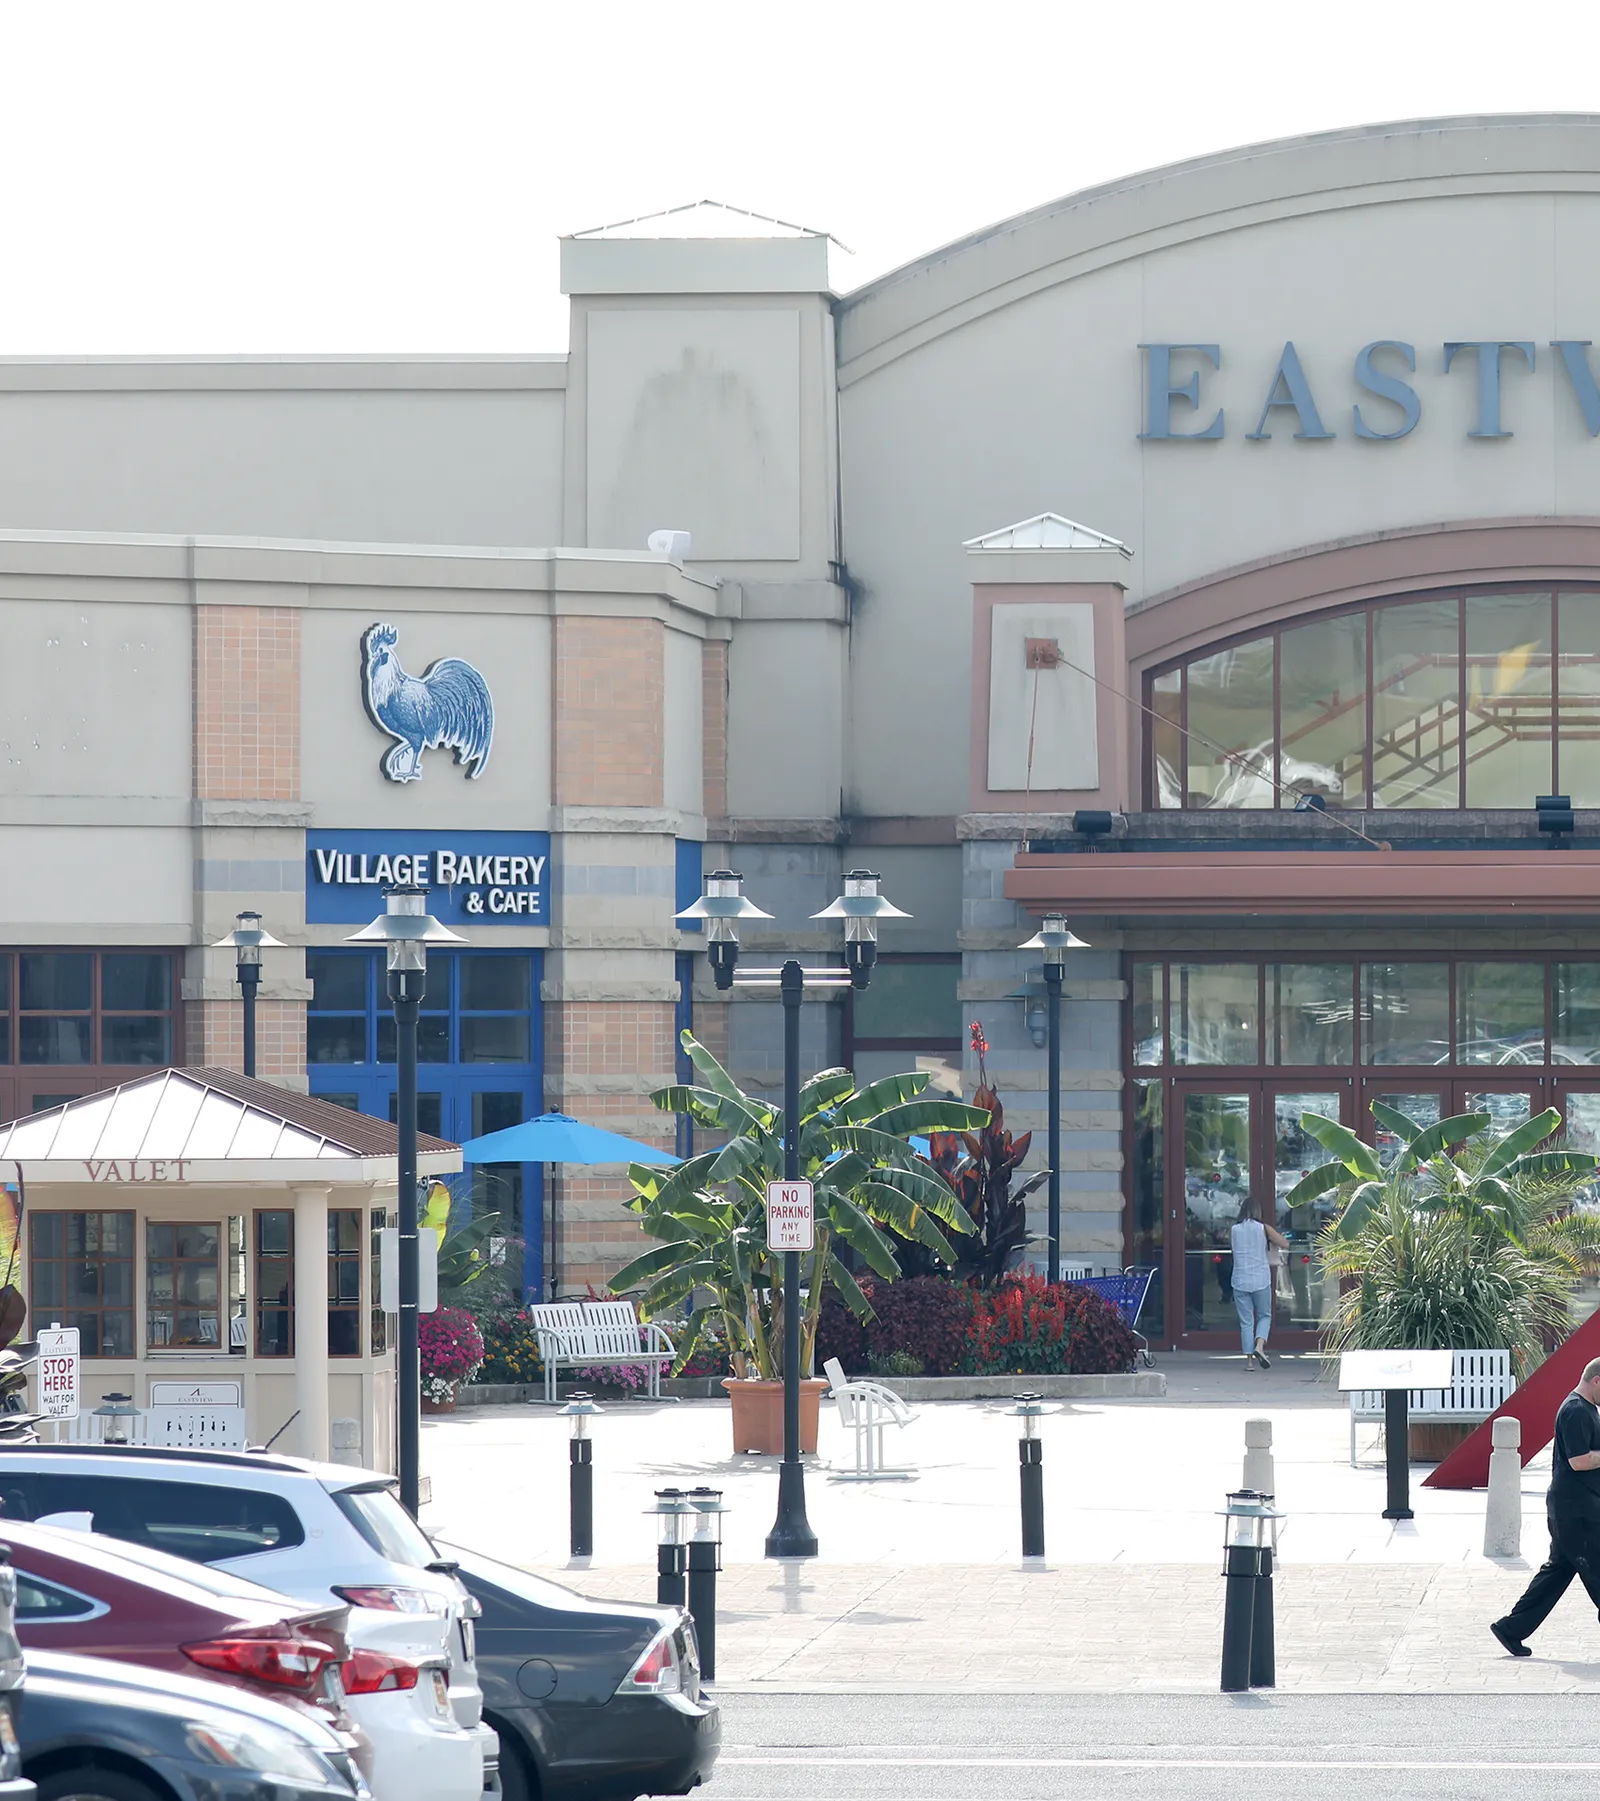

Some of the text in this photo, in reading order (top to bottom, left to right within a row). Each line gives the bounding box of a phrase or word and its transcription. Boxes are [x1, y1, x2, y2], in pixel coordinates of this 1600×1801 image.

[315, 848, 546, 885] VILLAGE BAKERY
[466, 887, 541, 914] & CAFE
[82, 1160, 192, 1182] VALET
[781, 1189, 799, 1203] NO
[771, 1205, 810, 1219] PARKING
[781, 1221, 800, 1231] ANY
[780, 1233, 801, 1243] TIME
[43, 1358, 74, 1375] STOP
[43, 1375, 74, 1391] HERE
[43, 1393, 75, 1404] WAIT FOR
[48, 1404, 69, 1415] VALET
